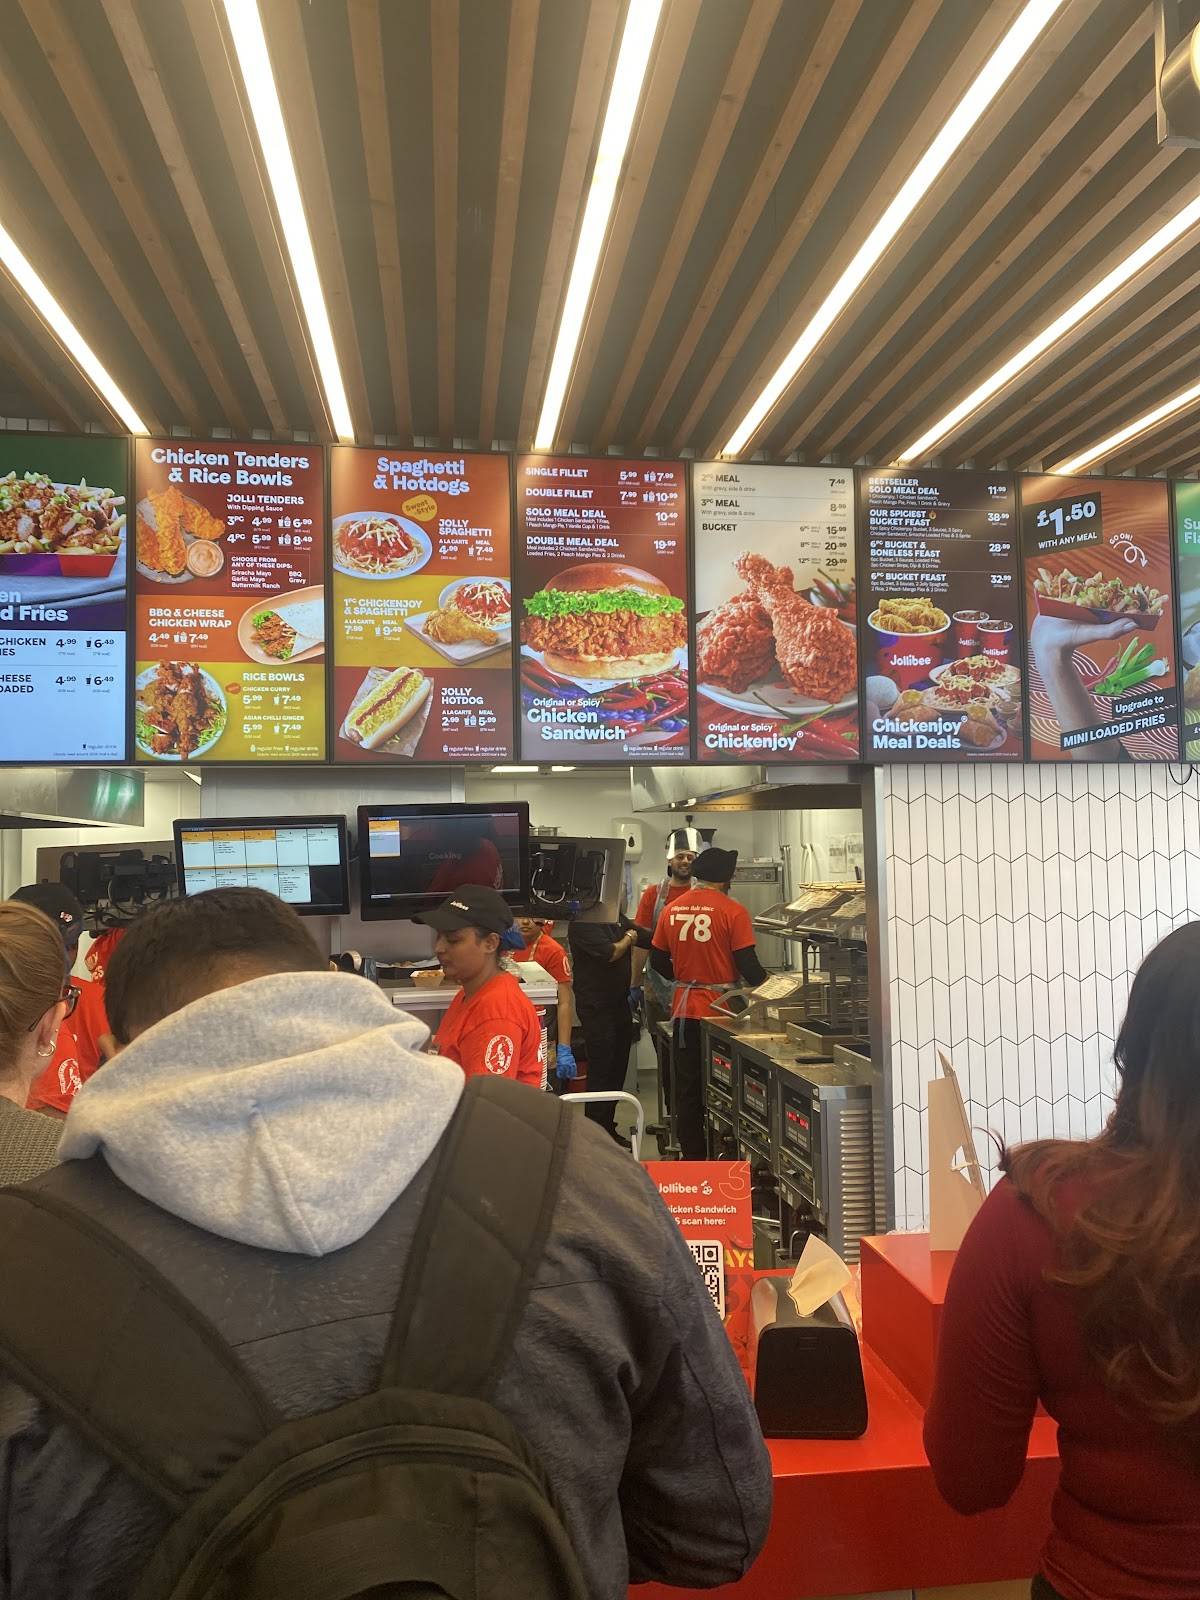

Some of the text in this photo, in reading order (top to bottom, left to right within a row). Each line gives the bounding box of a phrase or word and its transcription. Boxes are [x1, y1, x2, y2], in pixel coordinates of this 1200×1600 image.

[151, 448, 310, 469] Chicken Tenders
[377, 456, 465, 477] Spaghetti
[168, 468, 294, 487] & Rice Bowls
[525, 467, 674, 482] SINGLE FILLET 5.99 7.99
[373, 474, 471, 496] & Hotdogs
[715, 474, 846, 487] MEAL 7.49
[868, 477, 919, 487] BESTSELLER
[525, 487, 678, 502] DOUBLE FILLET 7.99 10.99
[868, 486, 892, 494] SOLO
[893, 486, 917, 495] MEAL
[917, 487, 940, 495] DEAL
[226, 493, 305, 505] JOLLI TENDERS
[715, 499, 740, 508] MEAL
[405, 499, 429, 512] Sweet
[525, 507, 679, 522] SOLO MEAL DEAL 10.49
[869, 509, 1010, 522] OUR SPICIEST 38.99
[1036, 501, 1096, 536] £1.50
[227, 515, 313, 528] 3PC 4.99 6.99
[438, 518, 469, 528] JOLLY
[869, 518, 931, 527] BUCKET FEAST
[438, 527, 492, 537] SPAGHETTI
[702, 523, 738, 532] BUCKET
[826, 526, 847, 535] 15.99
[226, 534, 313, 545] 4PC 5.99 8.49
[526, 536, 677, 550] DOUBLE MEAL DEAL 19.99
[1038, 531, 1098, 549] WITH ANY MEAL
[438, 545, 458, 555] 4.99
[475, 546, 494, 556] 7.49
[884, 541, 918, 549] BUCKET
[988, 543, 1011, 552] 28.99
[870, 549, 941, 558] BONELESS FEAST
[825, 558, 848, 567] 29.99
[885, 573, 919, 581] BUCKET
[920, 573, 947, 581] FEAST
[358, 598, 423, 609] CHICKENJOY
[20, 605, 69, 622] Fries
[149, 608, 225, 618] BBQ & CHEESE
[344, 607, 408, 616] & SPAGHETTI
[148, 618, 232, 628] CHICKEN WRAP
[148, 632, 209, 643] 4.49 7.49
[56, 639, 77, 648] 4.99
[94, 639, 115, 649] 6.49
[982, 647, 1009, 656] Jollibee
[890, 654, 933, 666] Jollibee
[55, 676, 77, 686] 4.99
[94, 676, 114, 686] 6.49
[242, 672, 305, 682] RICE BOWLS
[441, 687, 472, 696] JOLLY
[243, 695, 302, 705] 5.99 7.49
[441, 696, 484, 705] HOTDOG
[533, 697, 566, 708] Original
[577, 698, 601, 708] Spicy
[1115, 695, 1165, 714] Upgrade to
[527, 708, 598, 723] Chicken
[243, 724, 302, 734] 5.99 7.49
[541, 725, 626, 740] Sandwich
[708, 723, 739, 732] Original
[750, 723, 773, 732] Spicy
[1063, 713, 1166, 748] MINI LOADED FRIES
[872, 735, 962, 749] Meal Deals
[669, 913, 712, 943] '78
[667, 1204, 737, 1214] icken Sandwich
[681, 1217, 702, 1225] scan
[703, 1217, 726, 1225] here:
